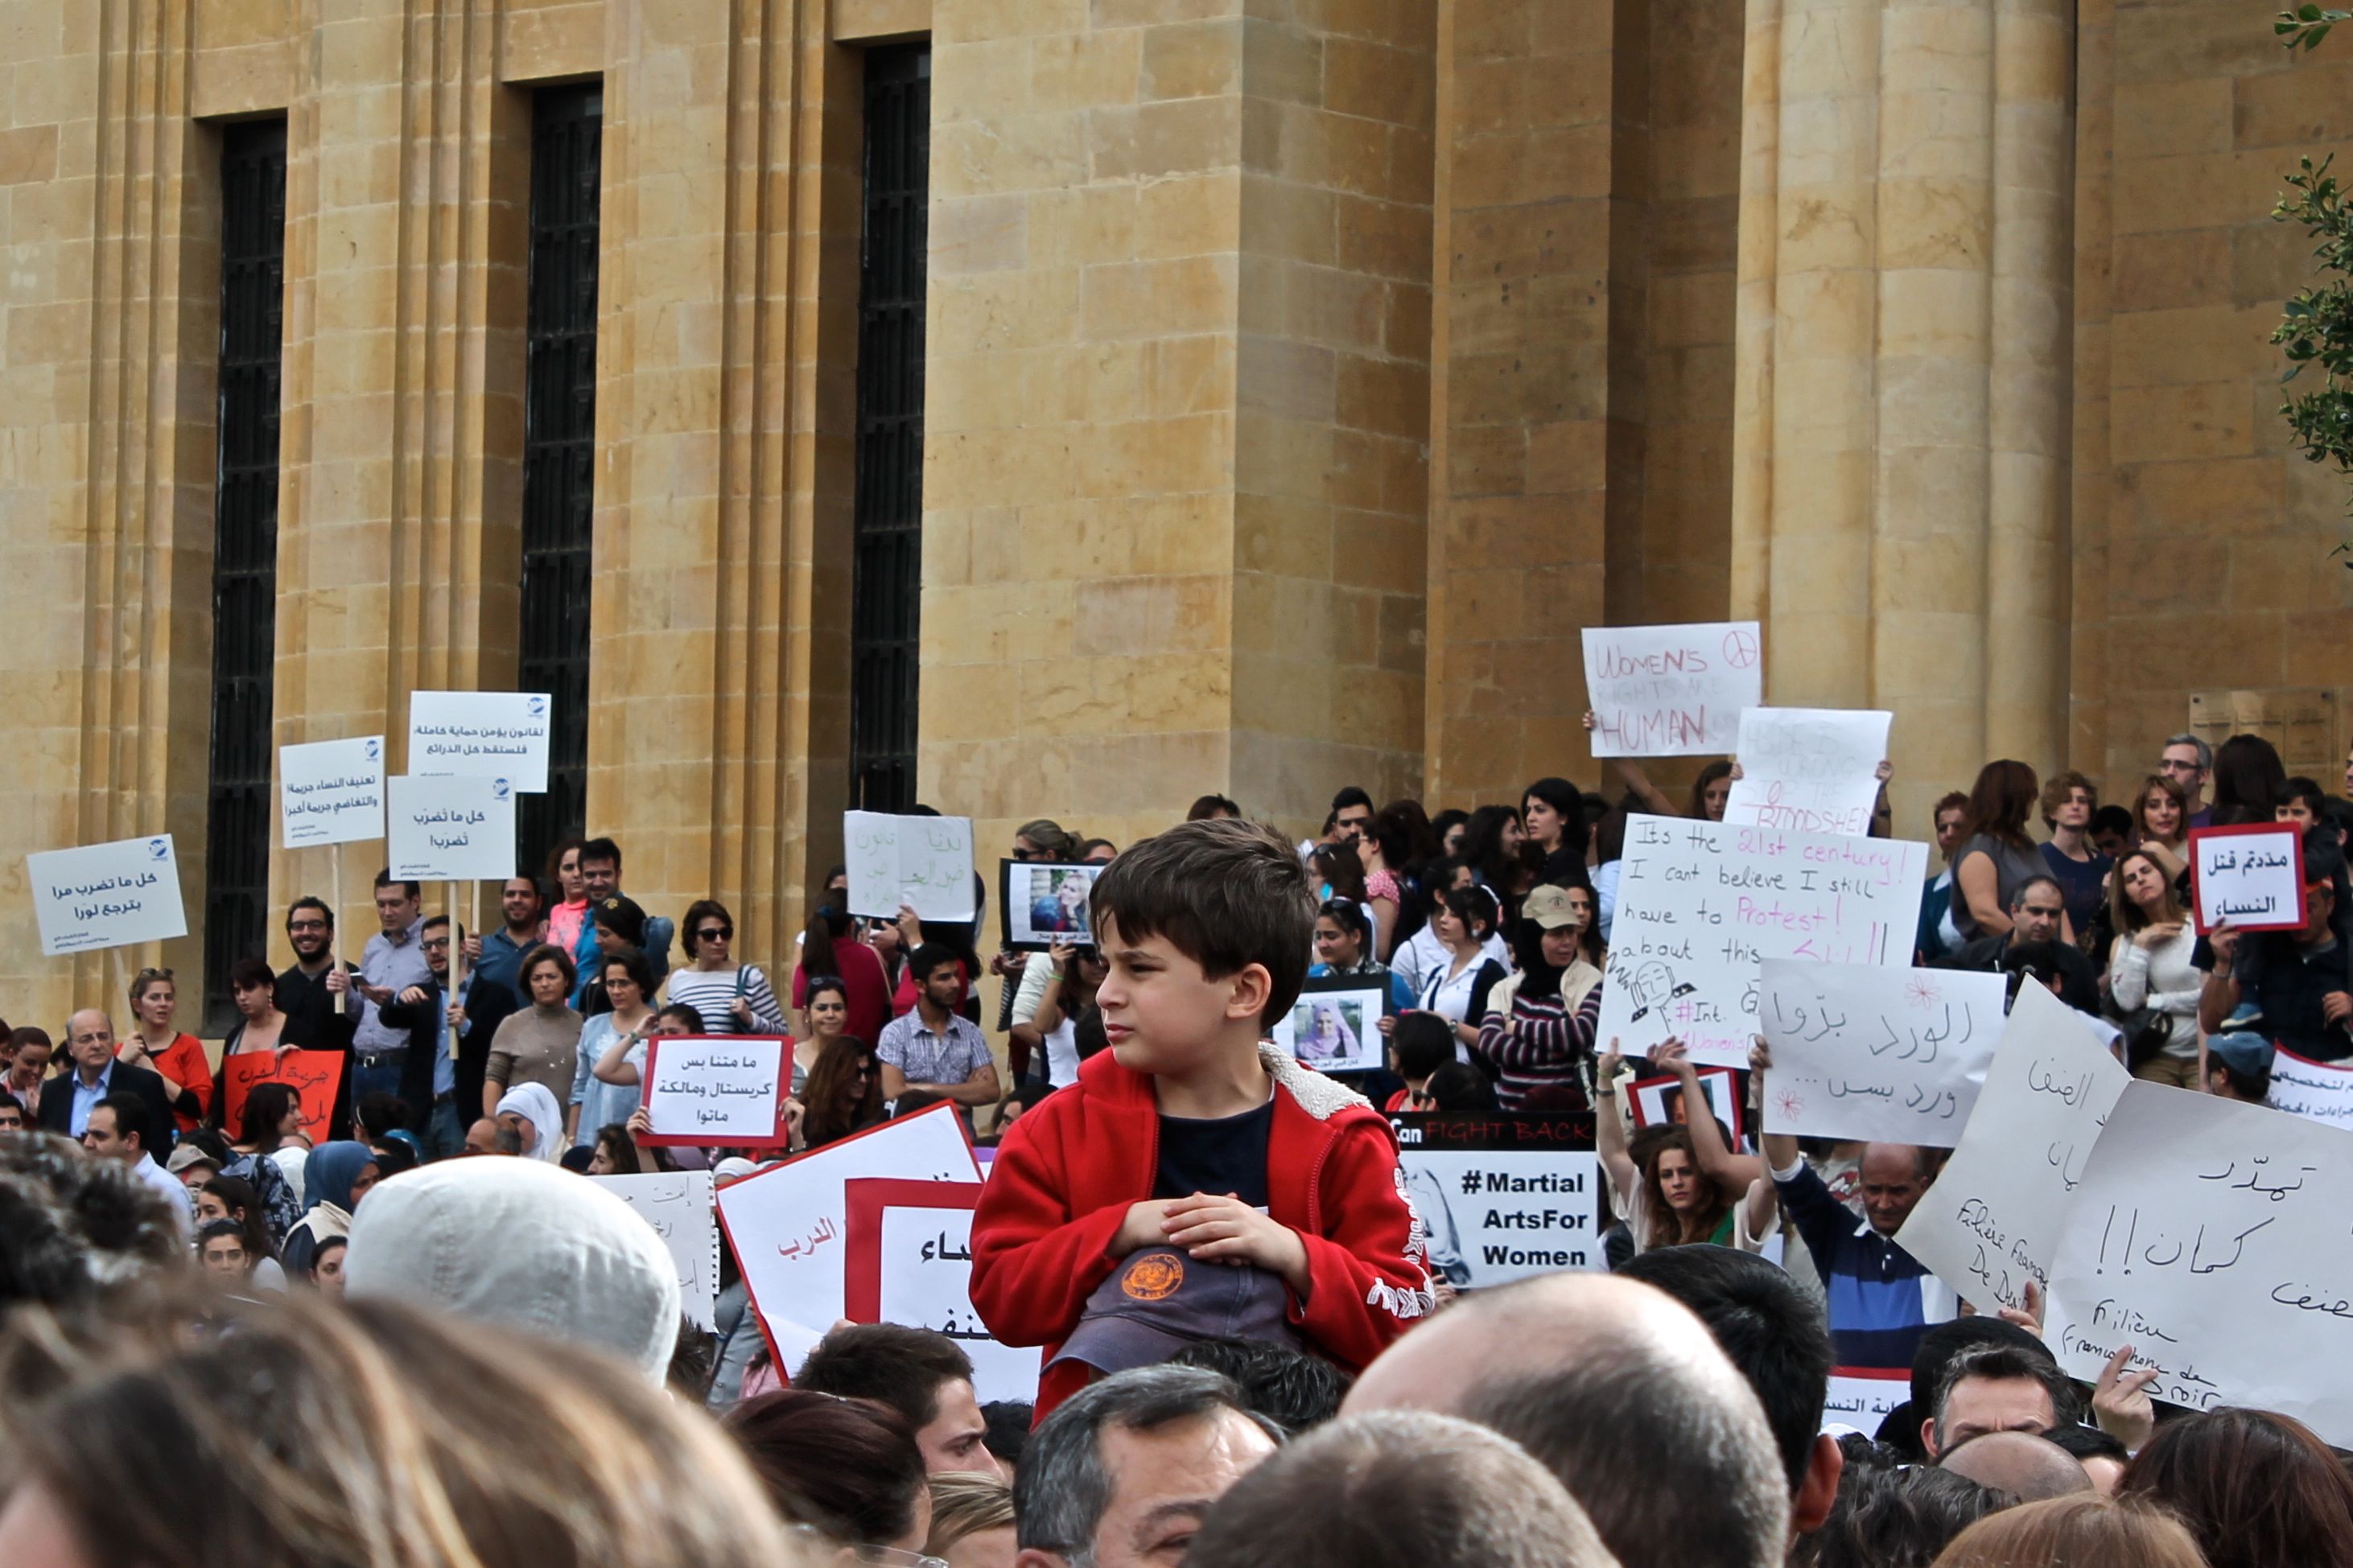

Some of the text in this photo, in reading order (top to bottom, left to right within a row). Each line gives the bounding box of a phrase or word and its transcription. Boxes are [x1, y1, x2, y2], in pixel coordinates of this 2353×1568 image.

[1600, 705, 1705, 752] HUMAN
[451, 810, 464, 822] ما
[1686, 825, 1722, 854] the
[1737, 828, 1788, 857] 21st
[2207, 850, 2237, 877] قتل
[75, 878, 115, 895] تضرب
[118, 876, 132, 888] ما
[135, 873, 158, 888] كل
[1629, 858, 1645, 880] I
[1719, 864, 1787, 891] believe
[1800, 870, 1819, 891] I
[1828, 875, 1875, 899] still
[101, 899, 142, 916] بترجع
[1625, 902, 1677, 924] have
[1696, 898, 1722, 925] to
[2215, 895, 2276, 916] النساء
[1621, 937, 1762, 965] about this
[681, 1055, 757, 1071] ما متنا بس
[657, 1079, 773, 1099] كريستال ومالكة
[697, 1109, 729, 1126] ماتوا
[1424, 1121, 1503, 1142] FIGHT
[1515, 1121, 1593, 1141] BACK
[1482, 1208, 1589, 1230] ArtsFor
[777, 1216, 837, 1261] الدرب
[1482, 1245, 1586, 1266] Women
